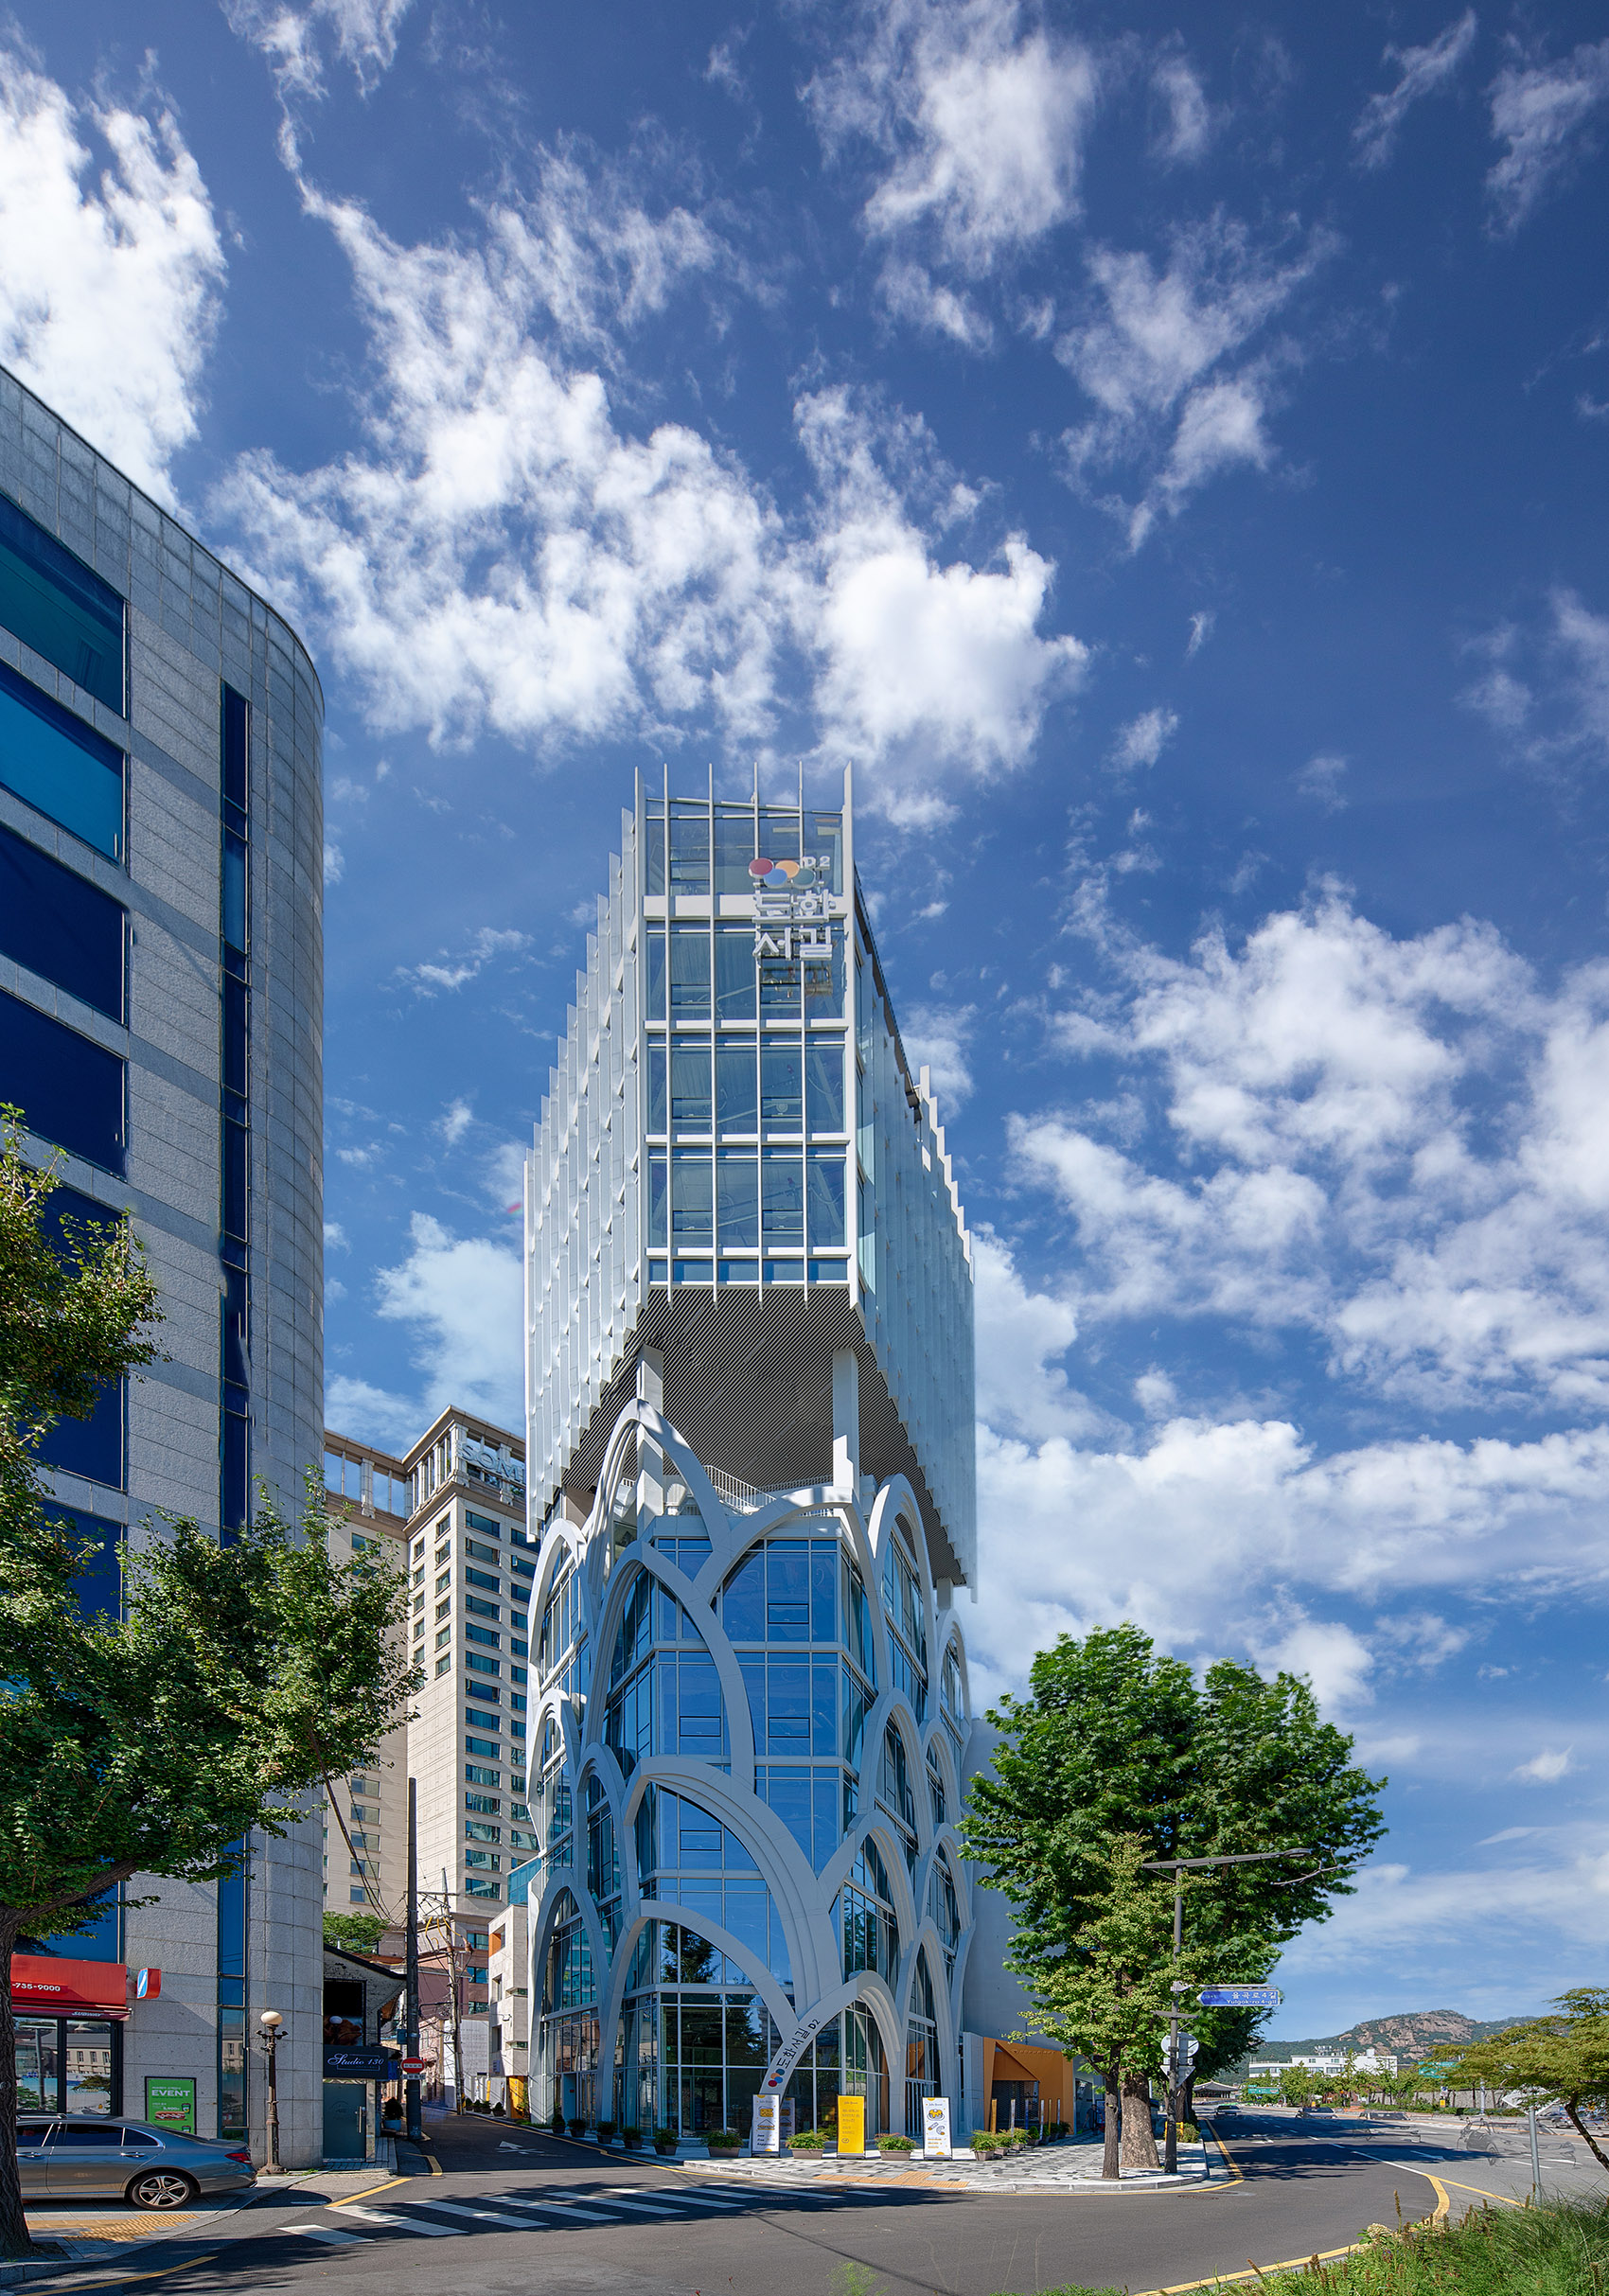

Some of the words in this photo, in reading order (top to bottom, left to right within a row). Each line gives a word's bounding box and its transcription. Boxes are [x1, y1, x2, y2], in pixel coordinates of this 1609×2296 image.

[803, 856, 830, 871] D2
[752, 889, 837, 924] 도화
[752, 926, 833, 962] 서길
[1231, 1991, 1277, 2000] 율곡로4길
[777, 2027, 811, 2069] 도화서길
[807, 2019, 822, 2030] D2
[327, 2053, 364, 2066] Studio
